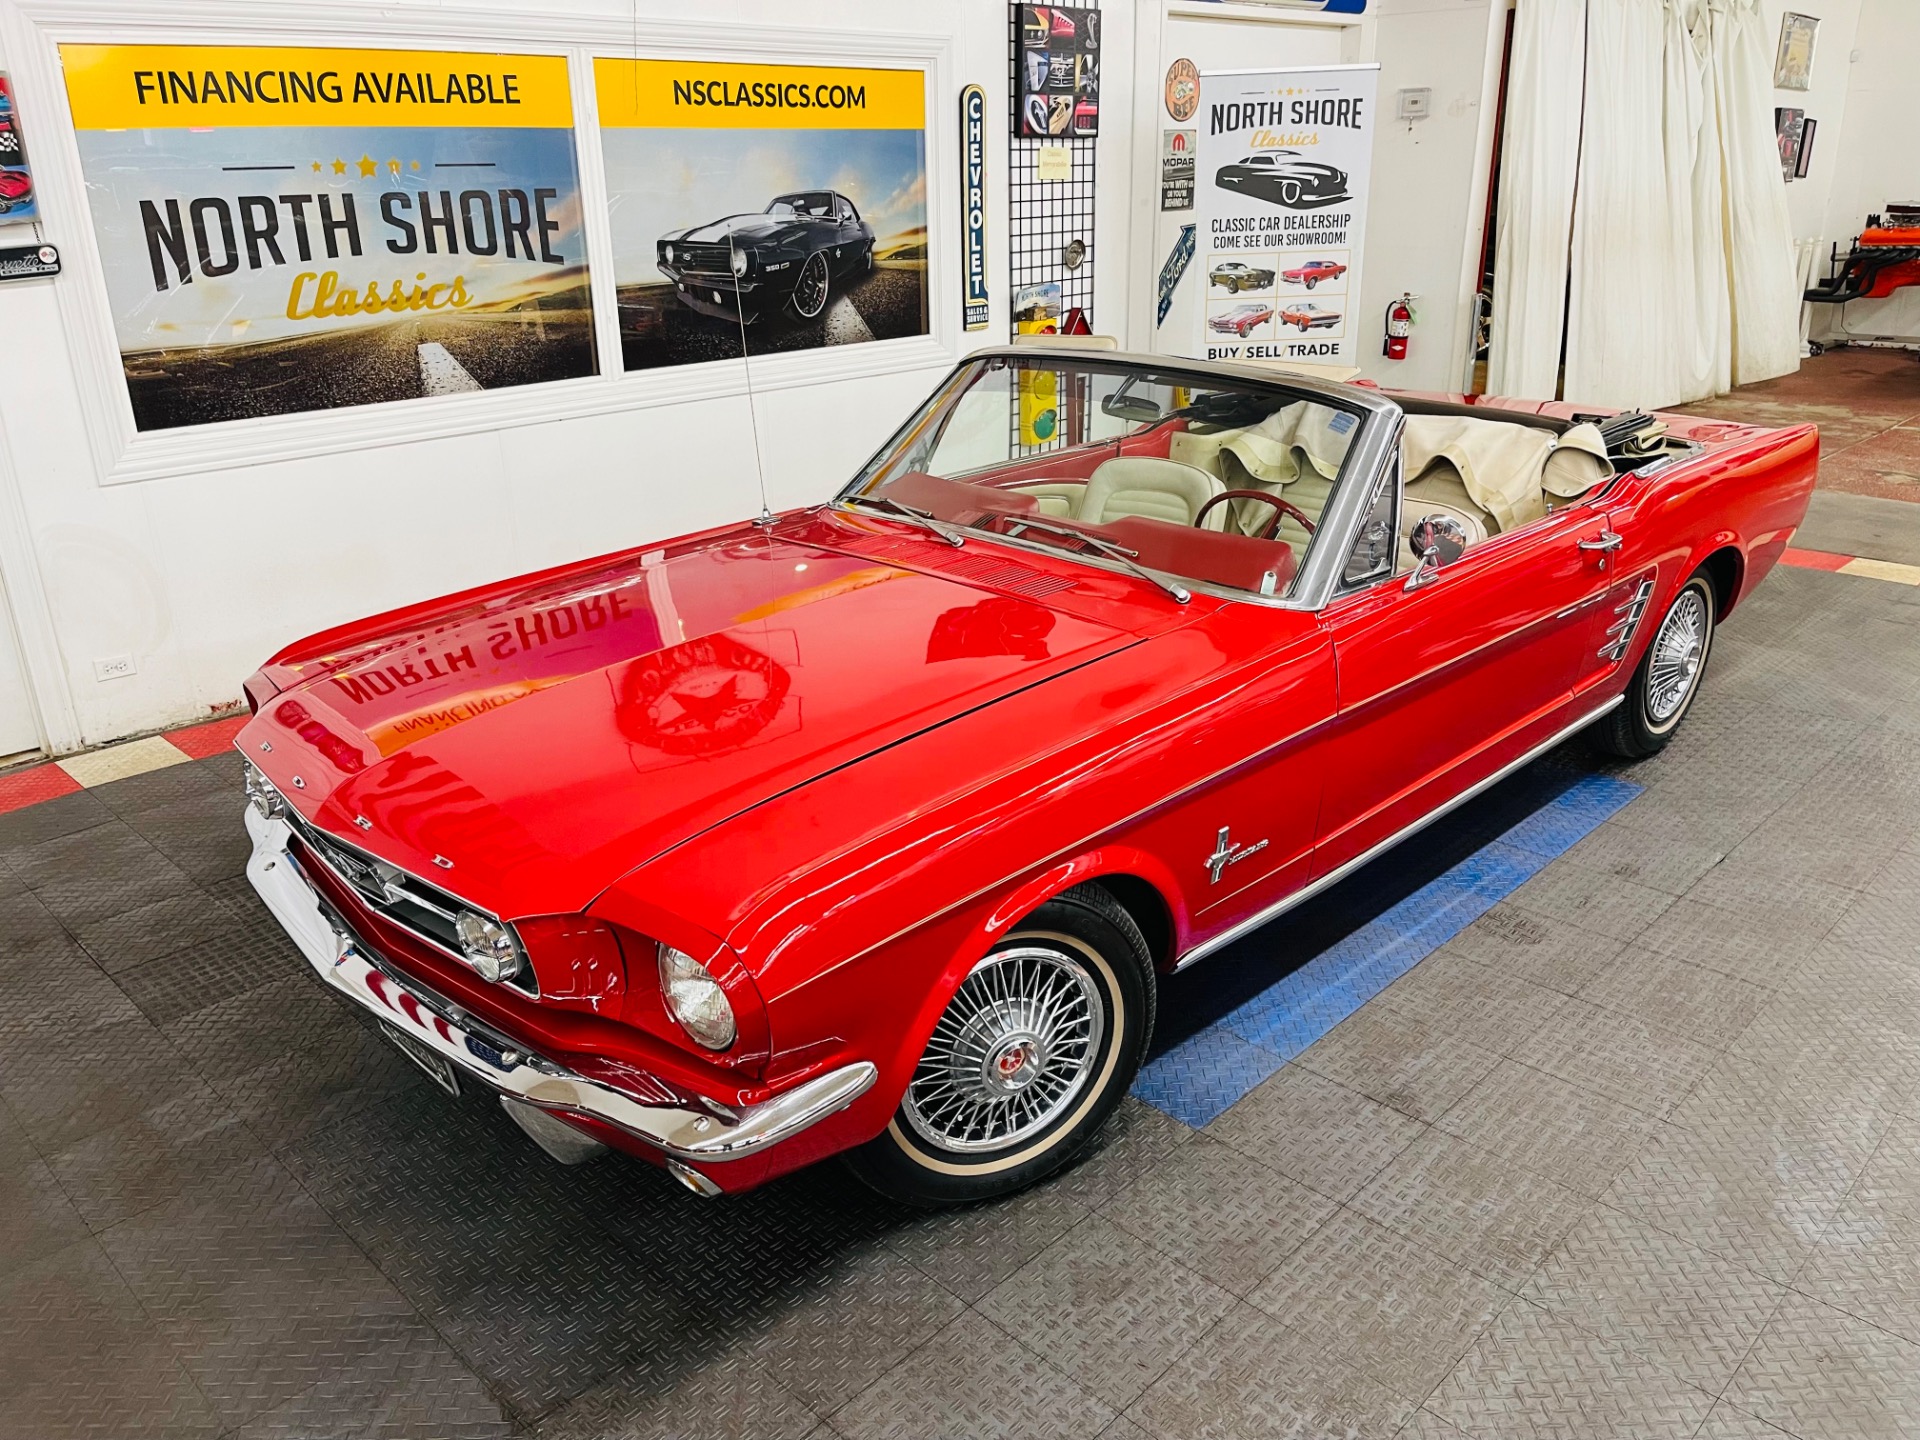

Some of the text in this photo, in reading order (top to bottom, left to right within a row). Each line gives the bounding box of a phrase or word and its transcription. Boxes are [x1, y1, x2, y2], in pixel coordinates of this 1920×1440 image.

[134, 70, 522, 105] FINANCING AVAILABLE
[1168, 61, 1197, 92] SUPER
[673, 79, 866, 109] NSCLASSICS.COM
[1172, 96, 1195, 118] BEE
[1211, 97, 1364, 136] NORTH SHORE
[1249, 129, 1320, 149] Classics
[1162, 157, 1195, 167] MOPAR
[969, 97, 983, 295] CHEVROLET
[1211, 213, 1351, 233] CLASSIC CAR DEALERSHIP
[138, 187, 565, 292] NORTH SHORE
[1213, 231, 1347, 249] COME SEE OUR SHOWROOM!
[1166, 245, 1189, 289] Ford
[286, 271, 474, 321] Classics
[967, 307, 983, 315] SALES
[967, 313, 988, 323] SERVICE
